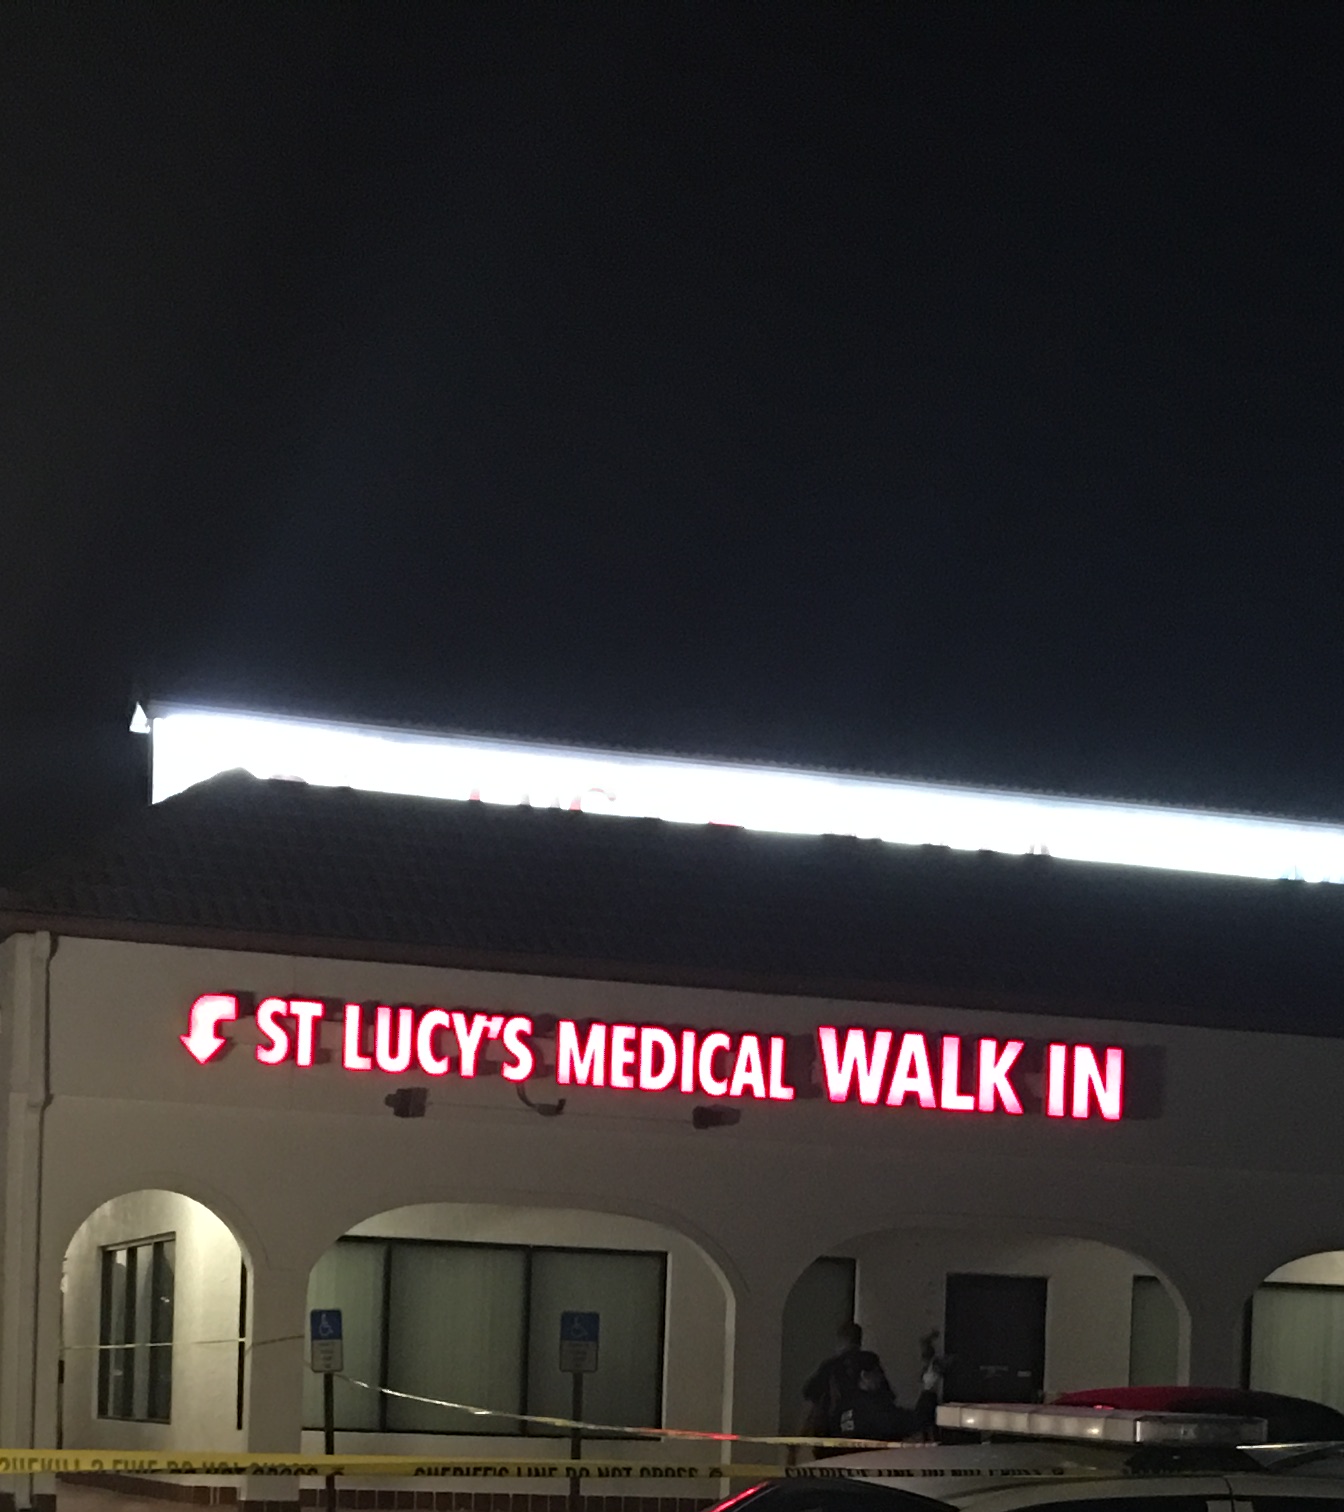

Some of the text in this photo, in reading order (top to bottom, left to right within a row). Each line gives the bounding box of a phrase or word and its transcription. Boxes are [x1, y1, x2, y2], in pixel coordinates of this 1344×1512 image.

[256, 997, 1127, 1123] ST LUCY'S MEDICAL WALK IN
